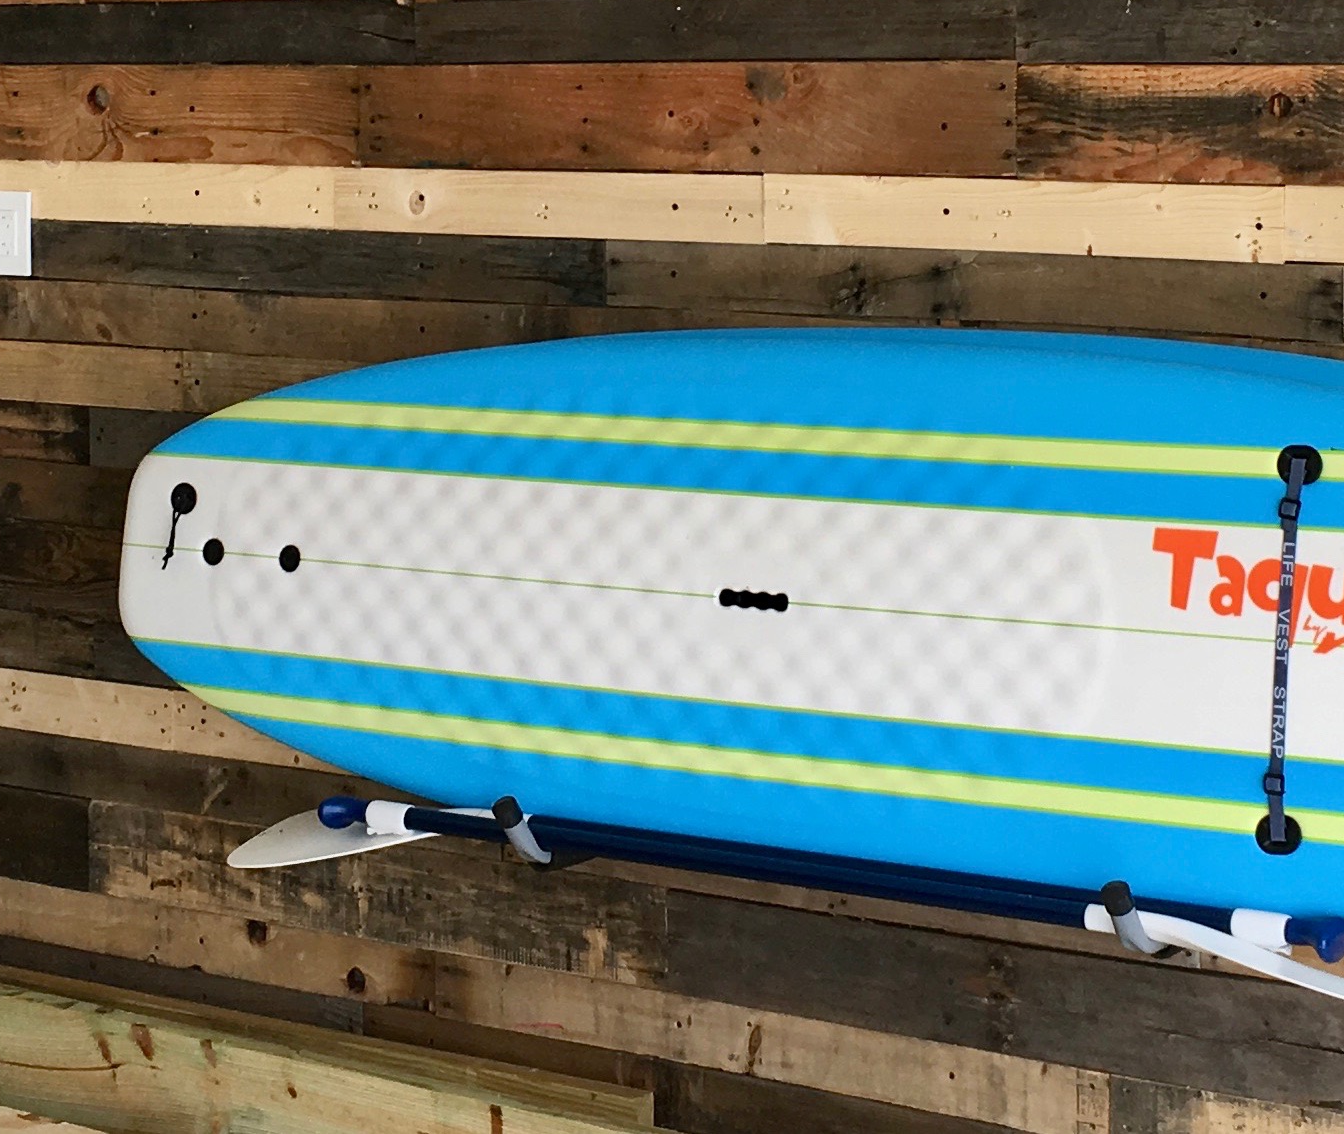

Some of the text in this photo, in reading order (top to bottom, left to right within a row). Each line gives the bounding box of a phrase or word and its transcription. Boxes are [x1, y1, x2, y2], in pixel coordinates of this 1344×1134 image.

[1271, 541, 1296, 759] LIFE VEST STRAP
[1302, 615, 1328, 644] by
